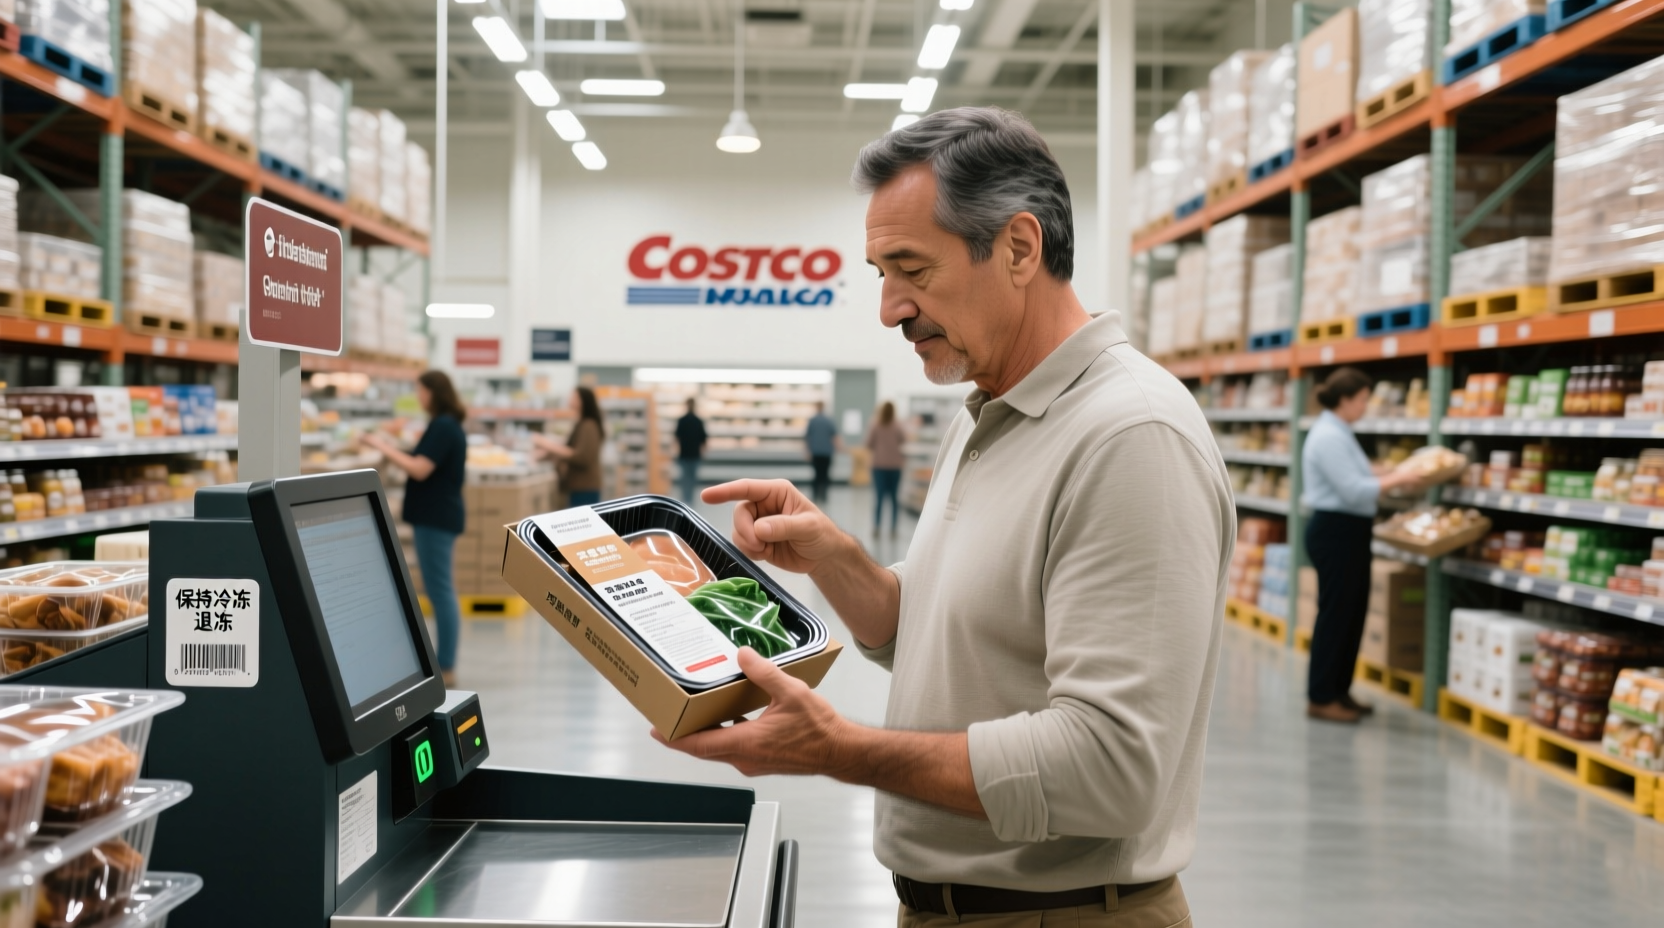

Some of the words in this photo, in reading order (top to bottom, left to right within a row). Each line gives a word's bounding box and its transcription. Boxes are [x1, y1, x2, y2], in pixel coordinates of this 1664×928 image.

[627, 235, 842, 282] COSTCO
[175, 588, 251, 610] 保持冷冻
[194, 611, 233, 632] 退冻
